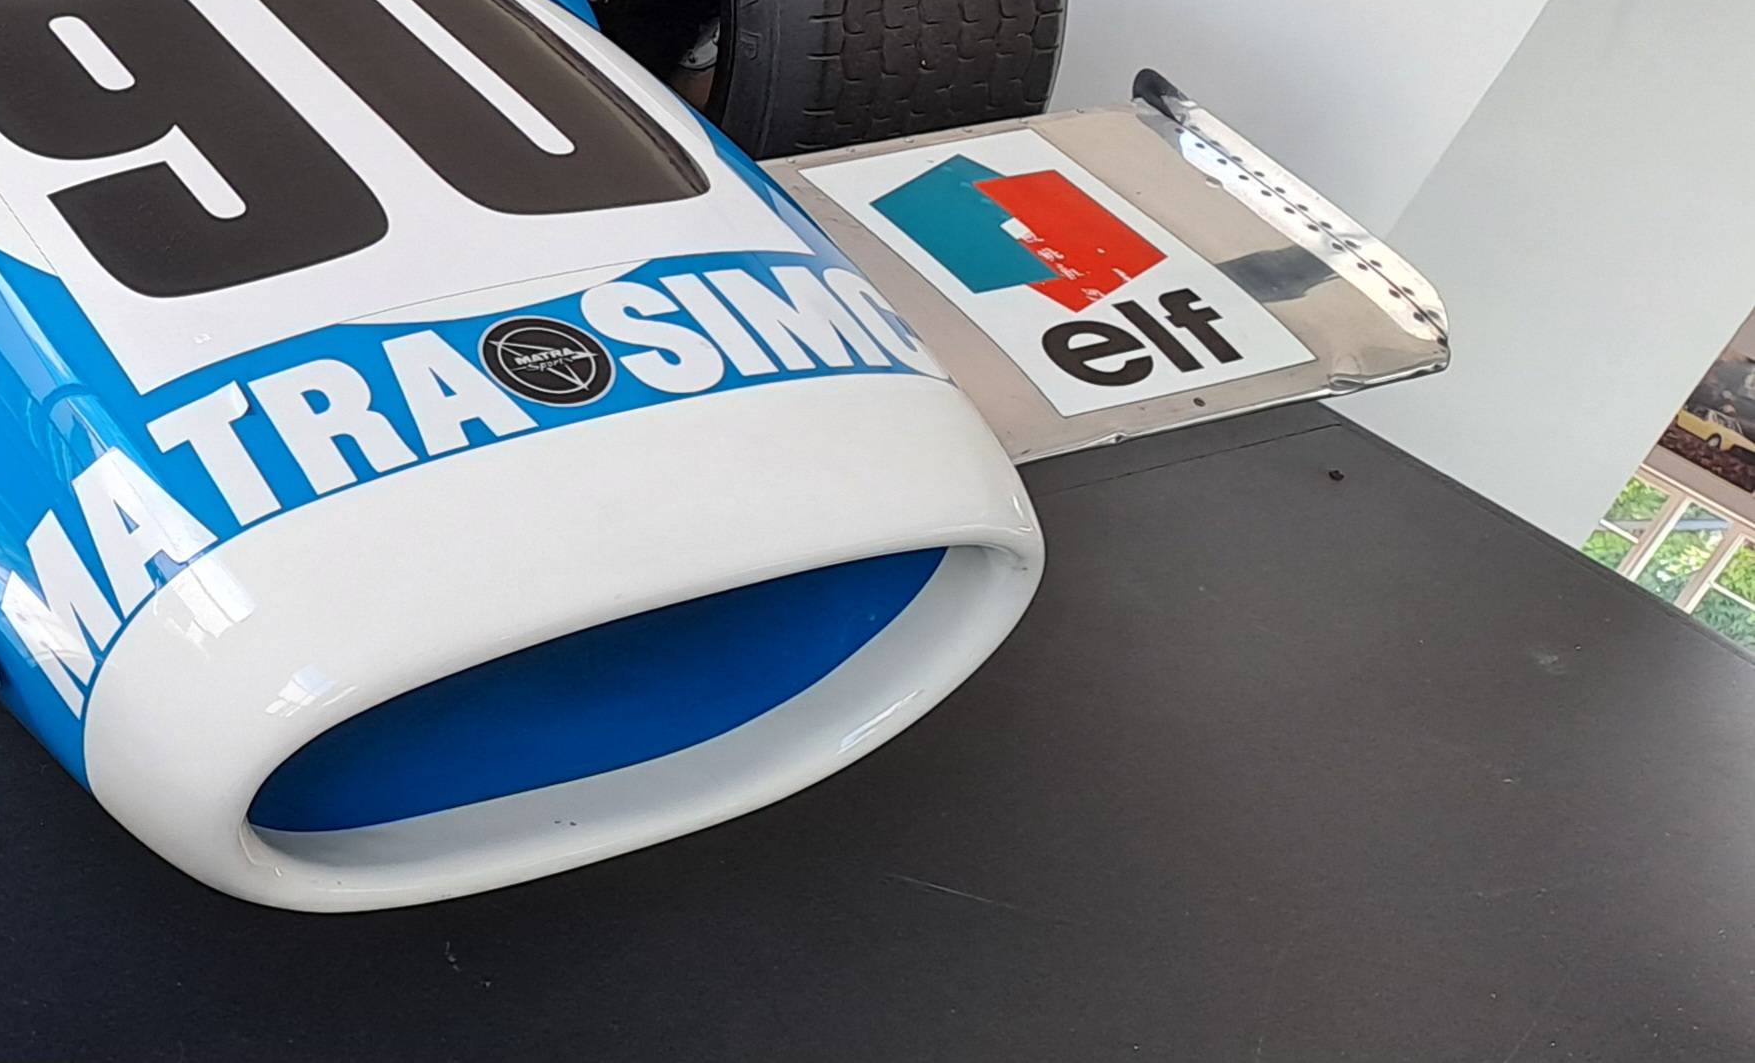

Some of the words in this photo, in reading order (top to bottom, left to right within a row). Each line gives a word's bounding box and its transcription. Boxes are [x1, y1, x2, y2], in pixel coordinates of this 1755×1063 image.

[514, 347, 574, 365] MATRA
[1042, 288, 1244, 387] elf
[1, 328, 540, 721] MATRA
[580, 264, 950, 396] SIMC
